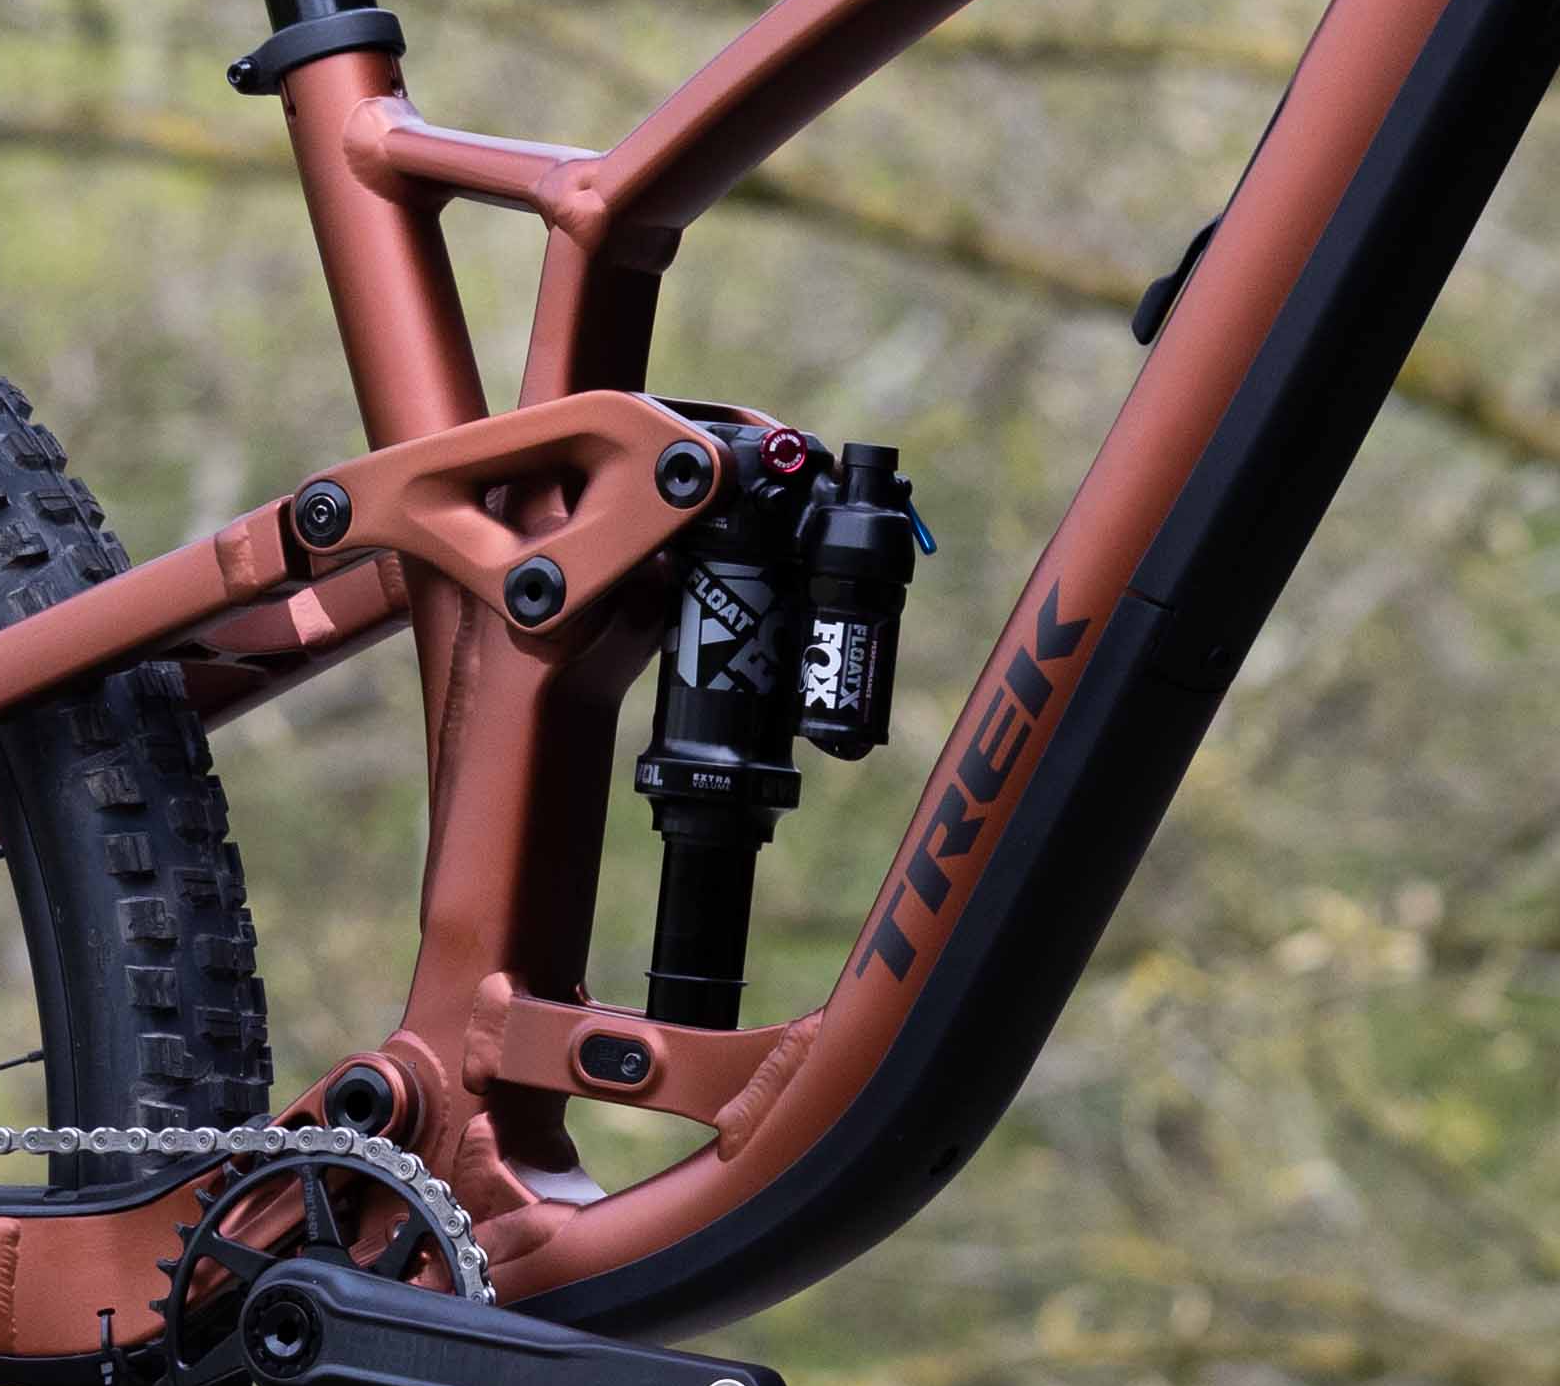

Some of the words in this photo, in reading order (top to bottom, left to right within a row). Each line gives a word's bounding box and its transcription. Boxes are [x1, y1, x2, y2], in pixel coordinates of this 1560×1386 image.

[802, 619, 844, 709] FOX
[693, 772, 731, 785] EXTRA
[856, 579, 1090, 982] TREK
